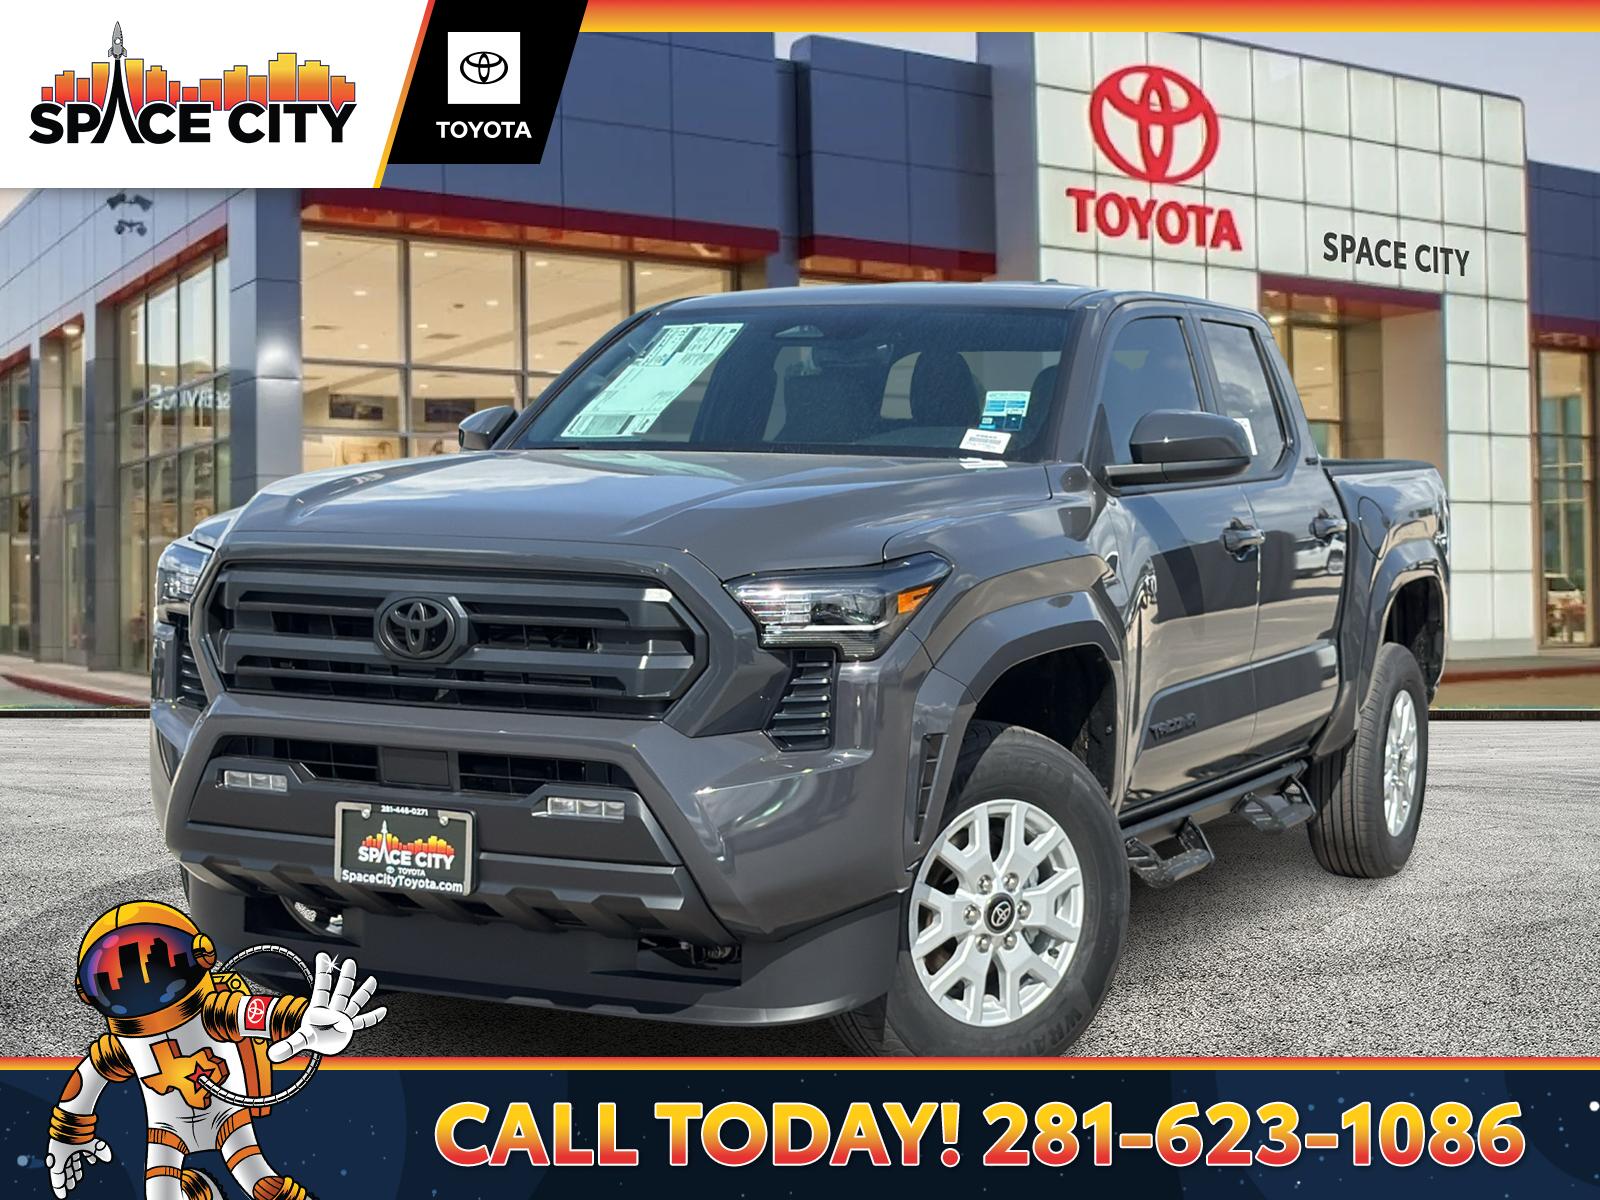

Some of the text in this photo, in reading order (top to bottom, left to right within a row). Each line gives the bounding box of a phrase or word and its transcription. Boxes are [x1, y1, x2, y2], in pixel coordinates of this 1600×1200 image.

[1065, 188, 1242, 251] TOYOTA
[1323, 232, 1470, 276] SPACE CITY
[358, 834, 455, 870] SPACE CITY
[342, 870, 463, 893] SpaceCityToyota.com
[398, 868, 426, 876] TOYOTA
